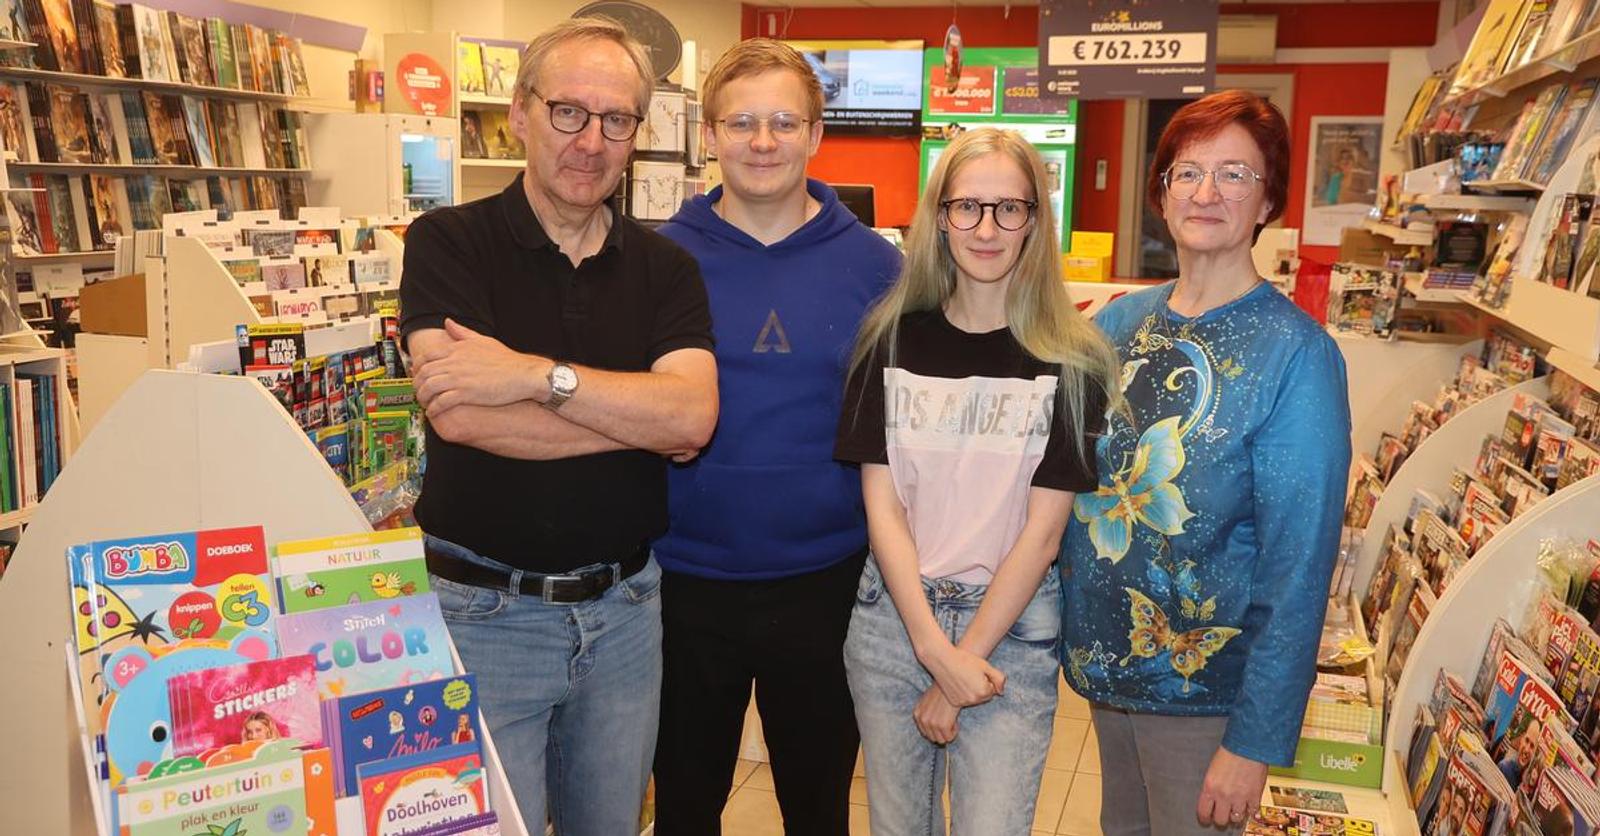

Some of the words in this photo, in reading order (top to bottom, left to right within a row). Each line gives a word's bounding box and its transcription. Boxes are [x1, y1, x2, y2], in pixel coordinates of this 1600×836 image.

[1091, 21, 1163, 32] EUROMILLIONS
[1073, 41, 1086, 60] €
[1093, 40, 1181, 60] 762.239
[268, 339, 296, 352] STAR
[268, 351, 297, 365] WARS
[206, 543, 254, 557] DOEBOEK
[327, 549, 382, 566] NATUUR
[104, 542, 188, 577] BUMBA
[230, 583, 255, 593] tellen
[175, 601, 213, 615] knippen
[308, 627, 430, 672] COLOR
[119, 661, 139, 677] 3+
[213, 680, 298, 720] STICKERS
[1320, 753, 1359, 773] Libelle
[162, 771, 273, 811] Peutertuin
[181, 812, 209, 830] plak
[211, 810, 227, 822] en
[229, 801, 260, 817] kleur
[387, 793, 468, 823] Doolhoven
